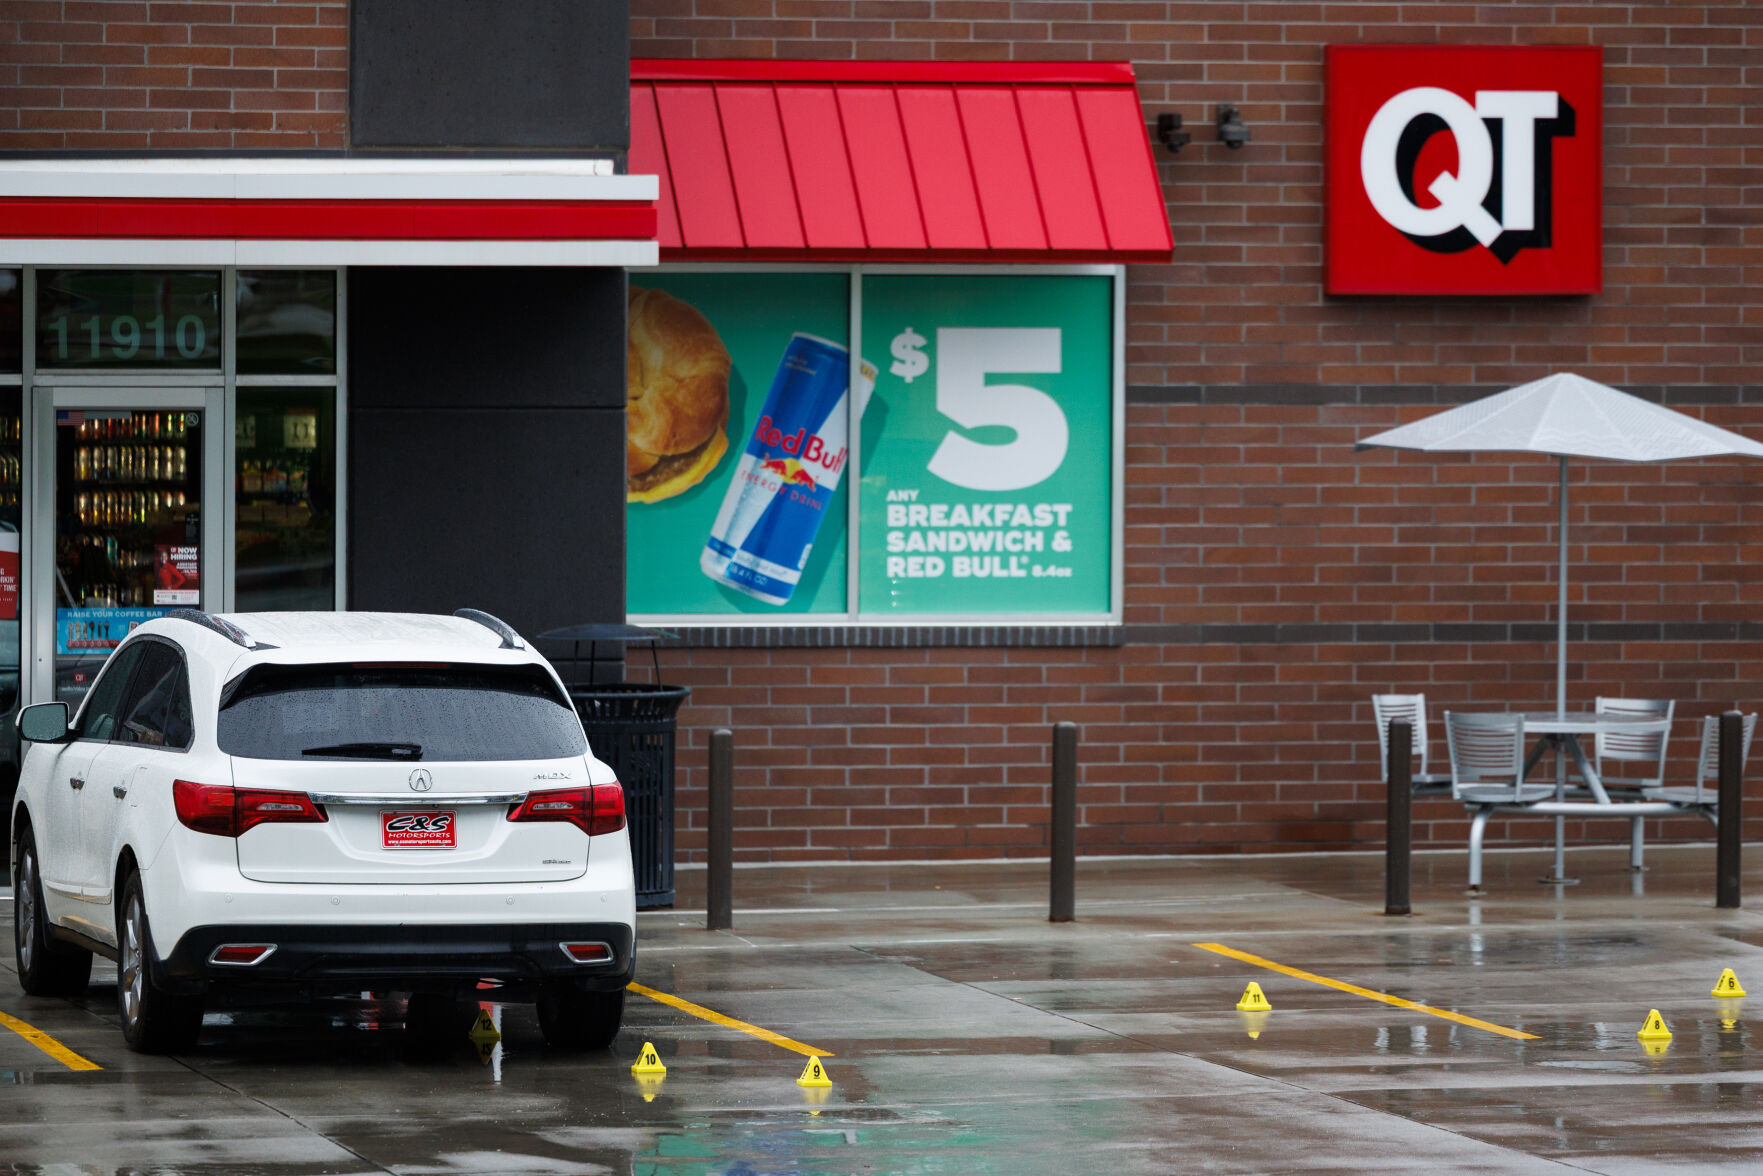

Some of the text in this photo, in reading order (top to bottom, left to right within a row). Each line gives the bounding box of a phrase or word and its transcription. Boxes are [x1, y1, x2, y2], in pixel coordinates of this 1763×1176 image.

[1360, 86, 1565, 252] QT
[48, 314, 205, 359] 11910
[755, 415, 849, 474] Red Bull
[886, 490, 919, 501] ANY
[887, 504, 1073, 527] BREAKFAST
[886, 530, 1073, 552] SANDWICH &
[886, 556, 946, 578] RED
[386, 815, 452, 832] C&S
[1728, 977, 1735, 988] 6
[1253, 993, 1260, 1003] 11
[481, 1019, 492, 1031] 12
[1654, 1020, 1660, 1030] 8
[645, 1053, 656, 1065] 10
[813, 1064, 820, 1078] 9
